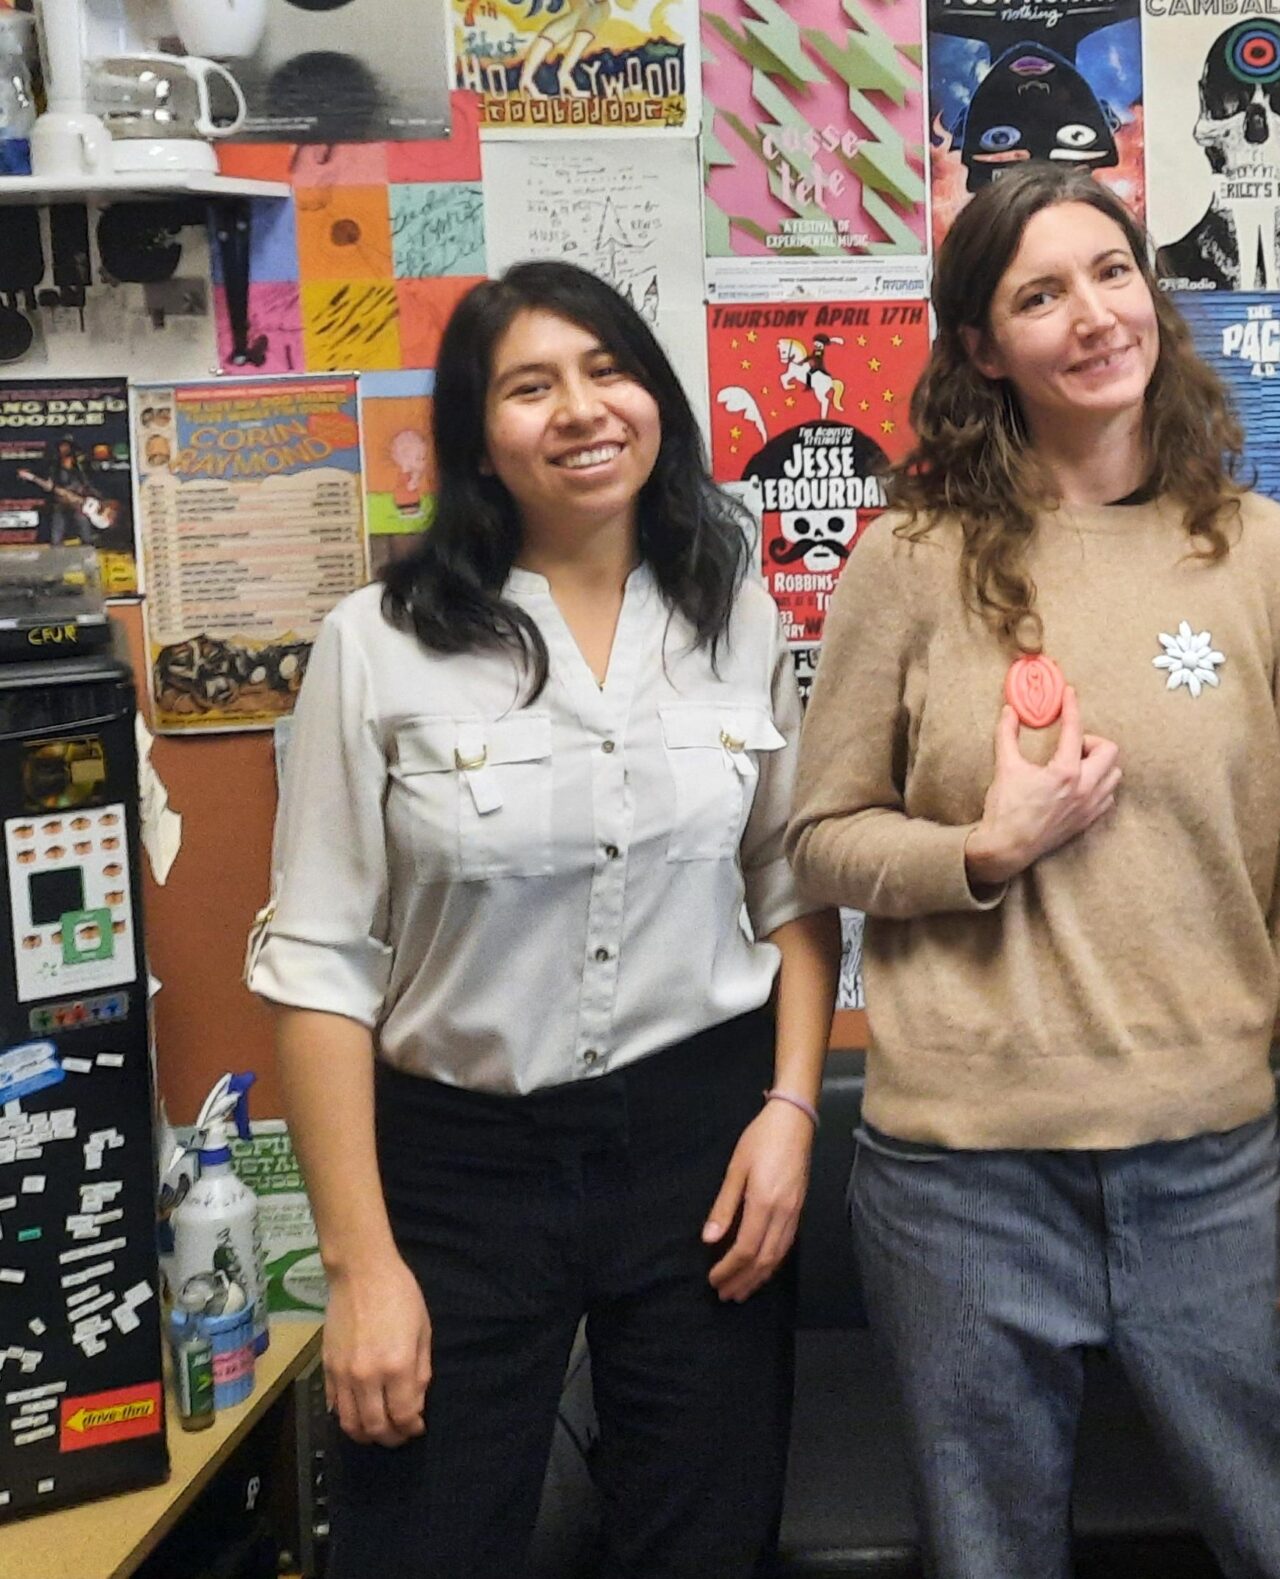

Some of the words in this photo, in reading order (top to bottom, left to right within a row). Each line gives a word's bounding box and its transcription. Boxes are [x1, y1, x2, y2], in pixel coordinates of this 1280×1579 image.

[1000, 5, 1063, 27] nothing
[711, 307, 809, 329] THURSDAY
[814, 305, 870, 327] APRIL
[880, 305, 924, 324] 17TH
[1246, 305, 1273, 319] THE
[48, 398, 128, 414] DANG
[190, 419, 308, 451] CORIN
[168, 436, 332, 475] RAYMOND
[783, 443, 855, 478] JESSE
[27, 625, 78, 646] CFUR
